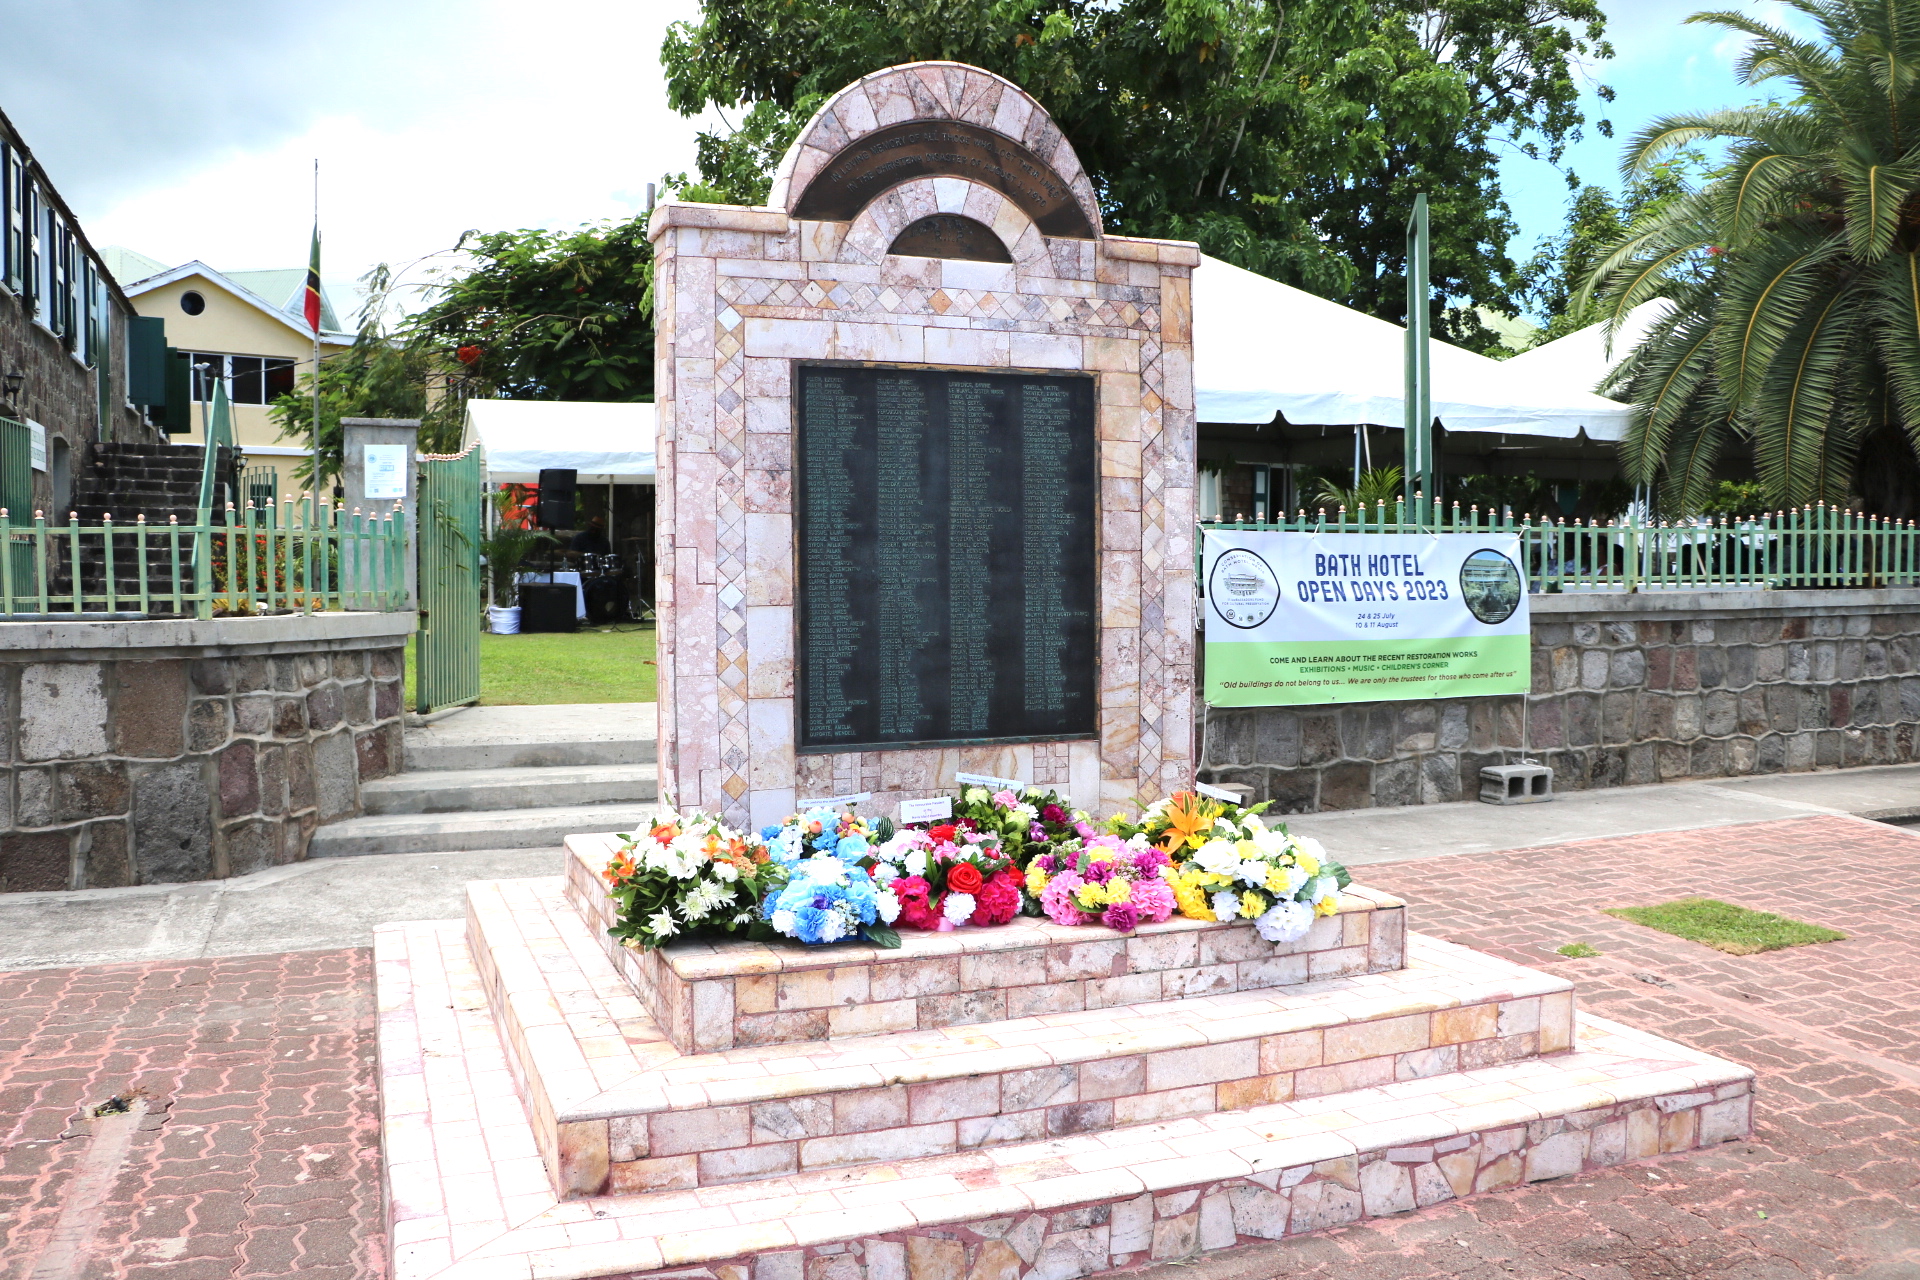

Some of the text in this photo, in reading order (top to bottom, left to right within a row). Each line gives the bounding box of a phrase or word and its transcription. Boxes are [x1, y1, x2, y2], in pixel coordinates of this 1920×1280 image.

[830, 174, 842, 184] IN
[840, 150, 870, 174] LOVING
[870, 136, 906, 156] MEMORY
[908, 133, 920, 144] OF
[924, 132, 940, 142] ALL
[942, 132, 971, 145] THOSE
[974, 138, 992, 150] WHO
[1019, 158, 1040, 180] THEIR
[1040, 177, 1060, 198] LIVES
[846, 180, 858, 192] IN
[856, 170, 874, 184] THE
[926, 152, 968, 164] DISASTER
[970, 158, 982, 166] OF
[984, 162, 1017, 182] AUGUST
[1026, 188, 1046, 207] 1970
[1315, 554, 1424, 576] BATH HOTEL
[1297, 580, 1449, 602] OPEN DAYS 2023
[1238, 680, 1272, 690] buildings
[1298, 680, 1321, 688] belong
